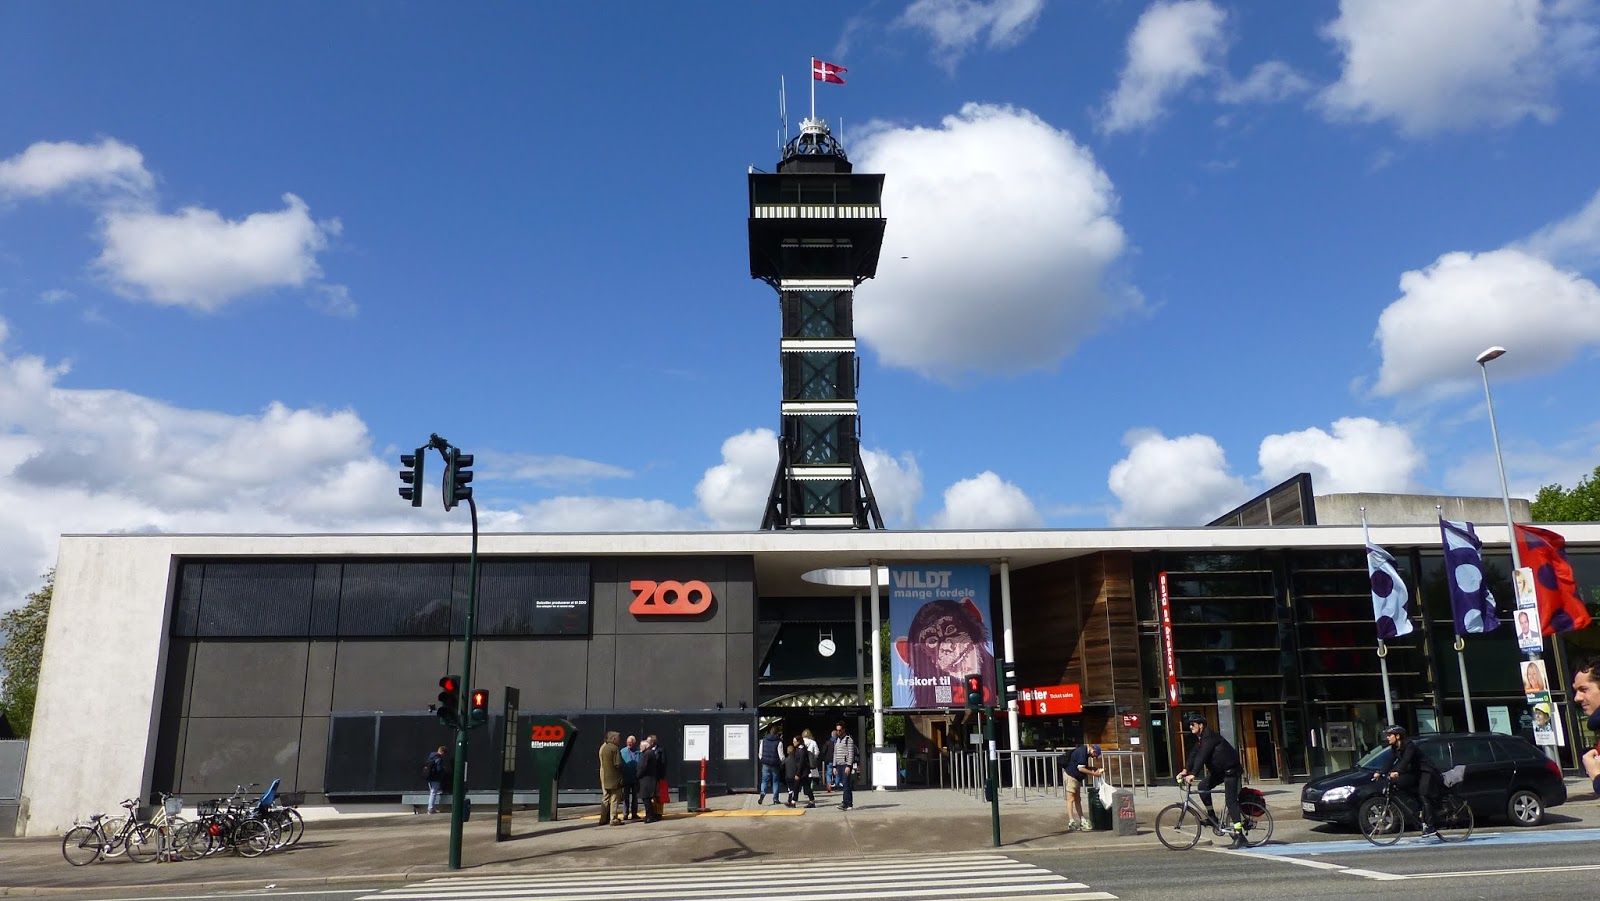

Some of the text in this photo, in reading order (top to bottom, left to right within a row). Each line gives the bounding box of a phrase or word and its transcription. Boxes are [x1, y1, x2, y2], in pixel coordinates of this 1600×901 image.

[892, 571, 952, 588] VILDT
[629, 580, 713, 615] ZOO
[894, 588, 976, 599] mange fordele
[897, 674, 951, 686] Årskort til
[952, 686, 991, 703] ZO
[1017, 690, 1048, 701] illetter
[1040, 702, 1047, 714] 3
[531, 725, 565, 741] ZOO
